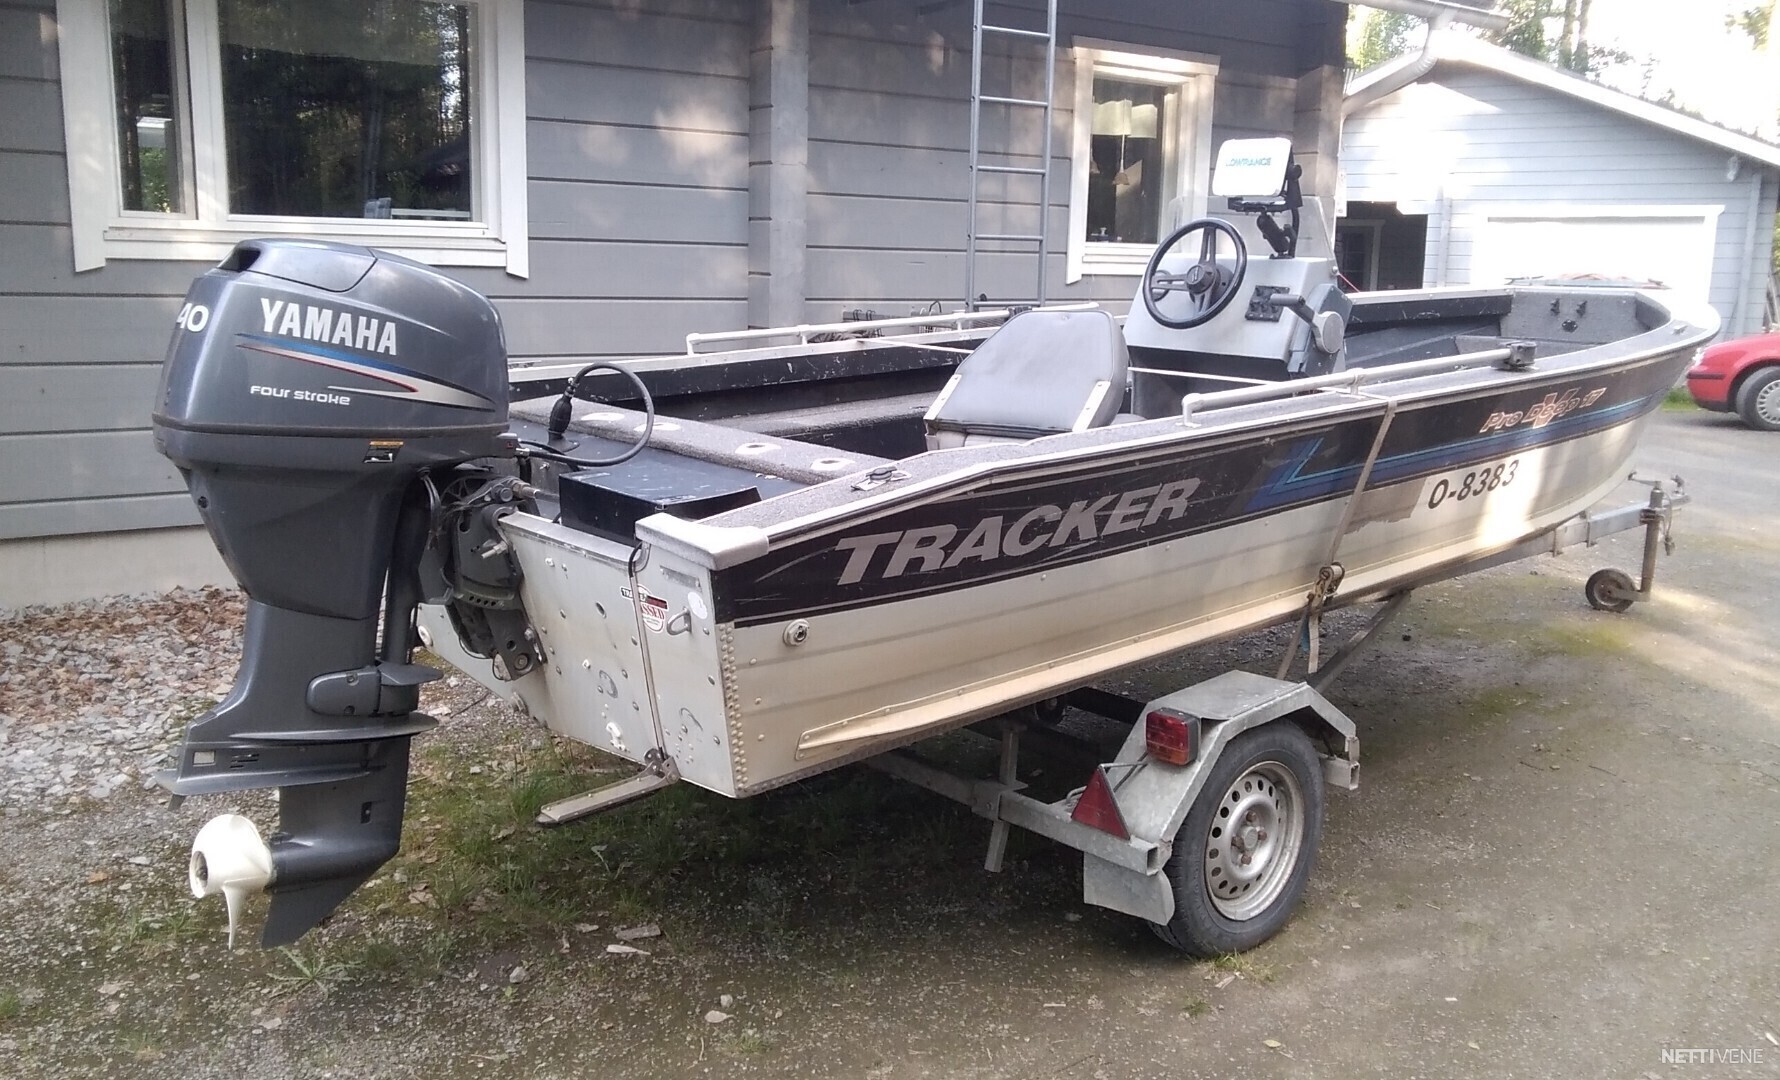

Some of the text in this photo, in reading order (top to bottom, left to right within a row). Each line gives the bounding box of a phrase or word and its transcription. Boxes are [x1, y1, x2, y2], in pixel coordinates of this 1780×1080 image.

[176, 302, 209, 332] 40
[260, 297, 398, 356] YAMAHA
[1479, 411, 1523, 433] Pro
[834, 477, 1200, 586] TRACKER
